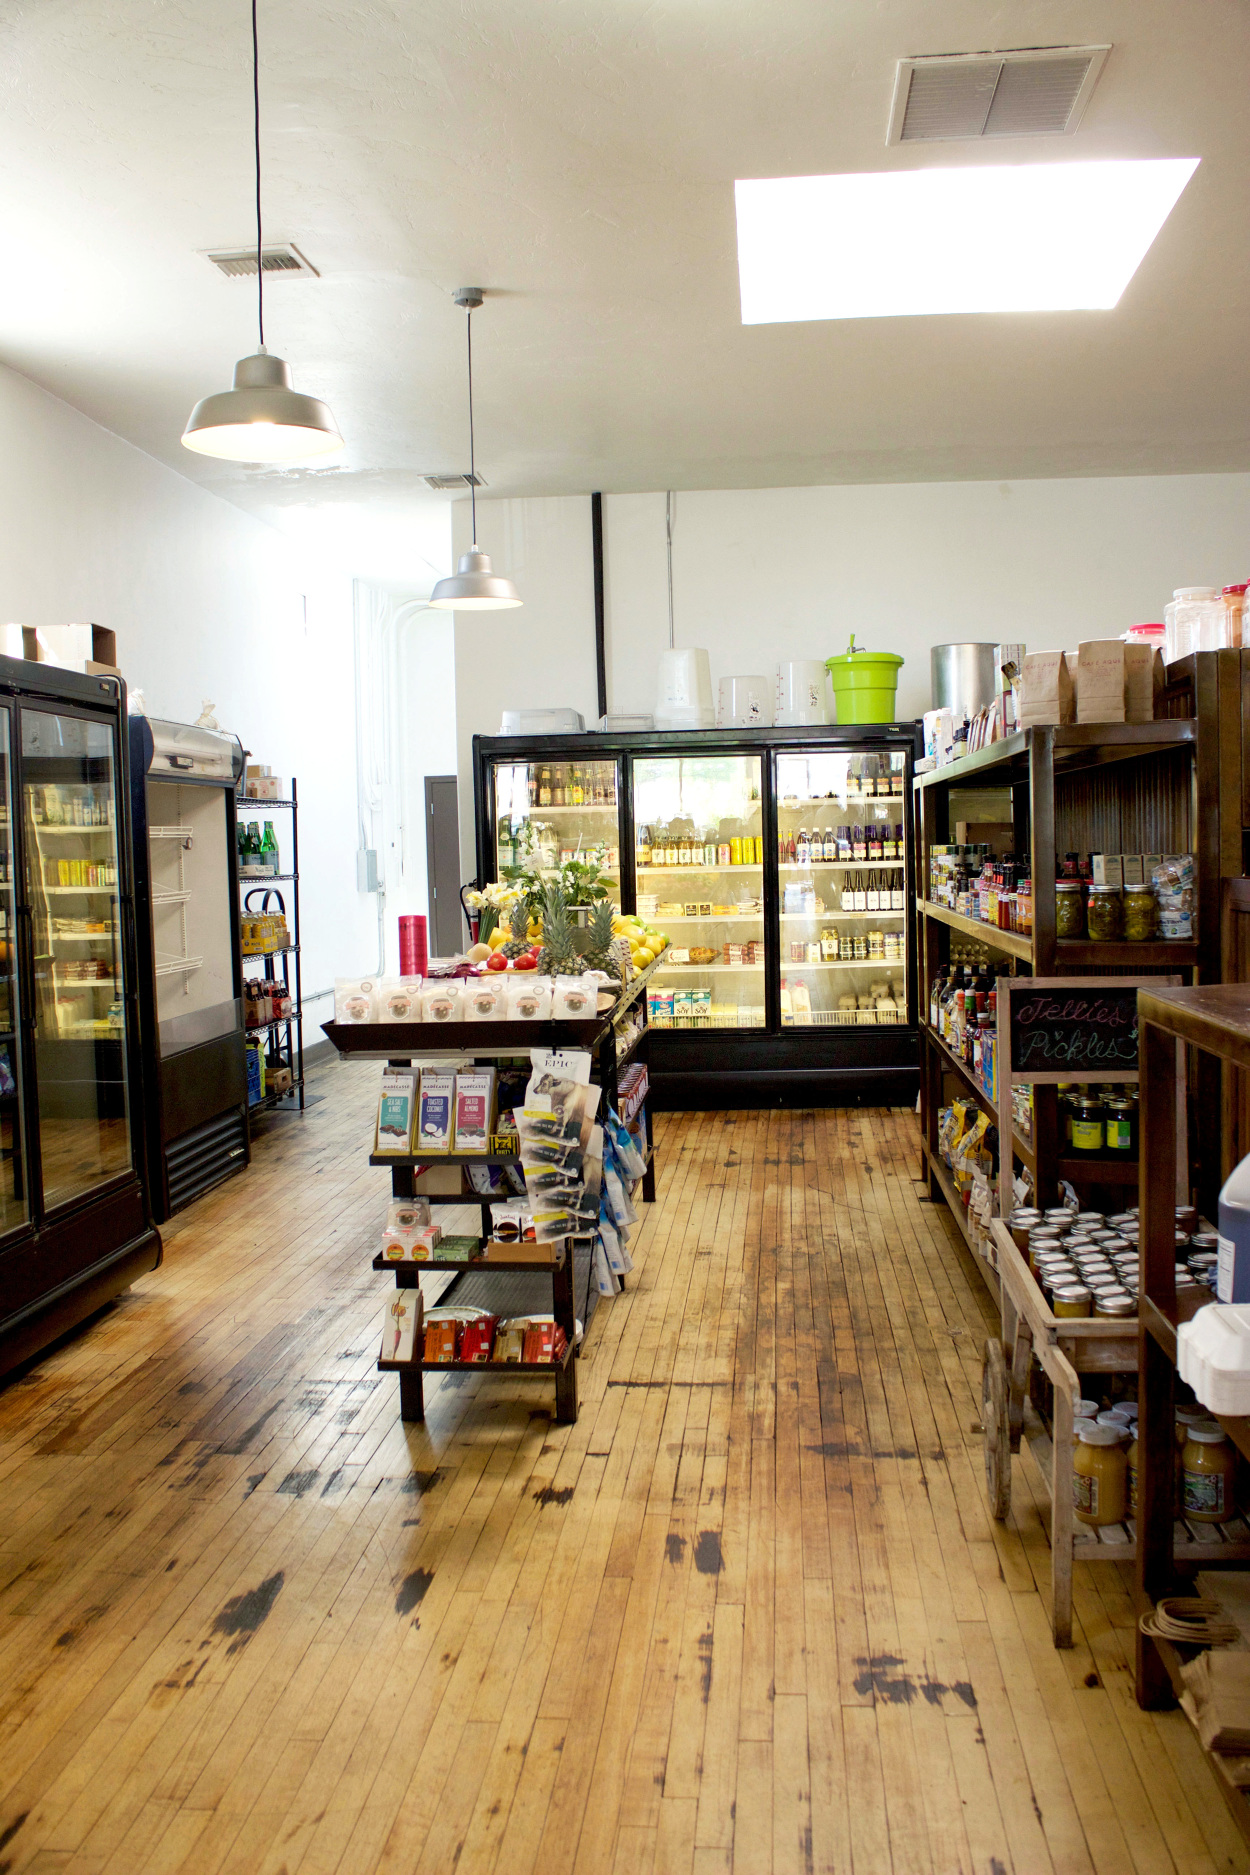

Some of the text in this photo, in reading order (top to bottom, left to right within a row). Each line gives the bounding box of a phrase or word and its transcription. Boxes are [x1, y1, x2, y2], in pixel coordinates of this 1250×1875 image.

[1019, 1030, 1138, 1065] Pickles
[544, 1059, 573, 1069] EPIC
[428, 1098, 443, 1106] TOASTED
